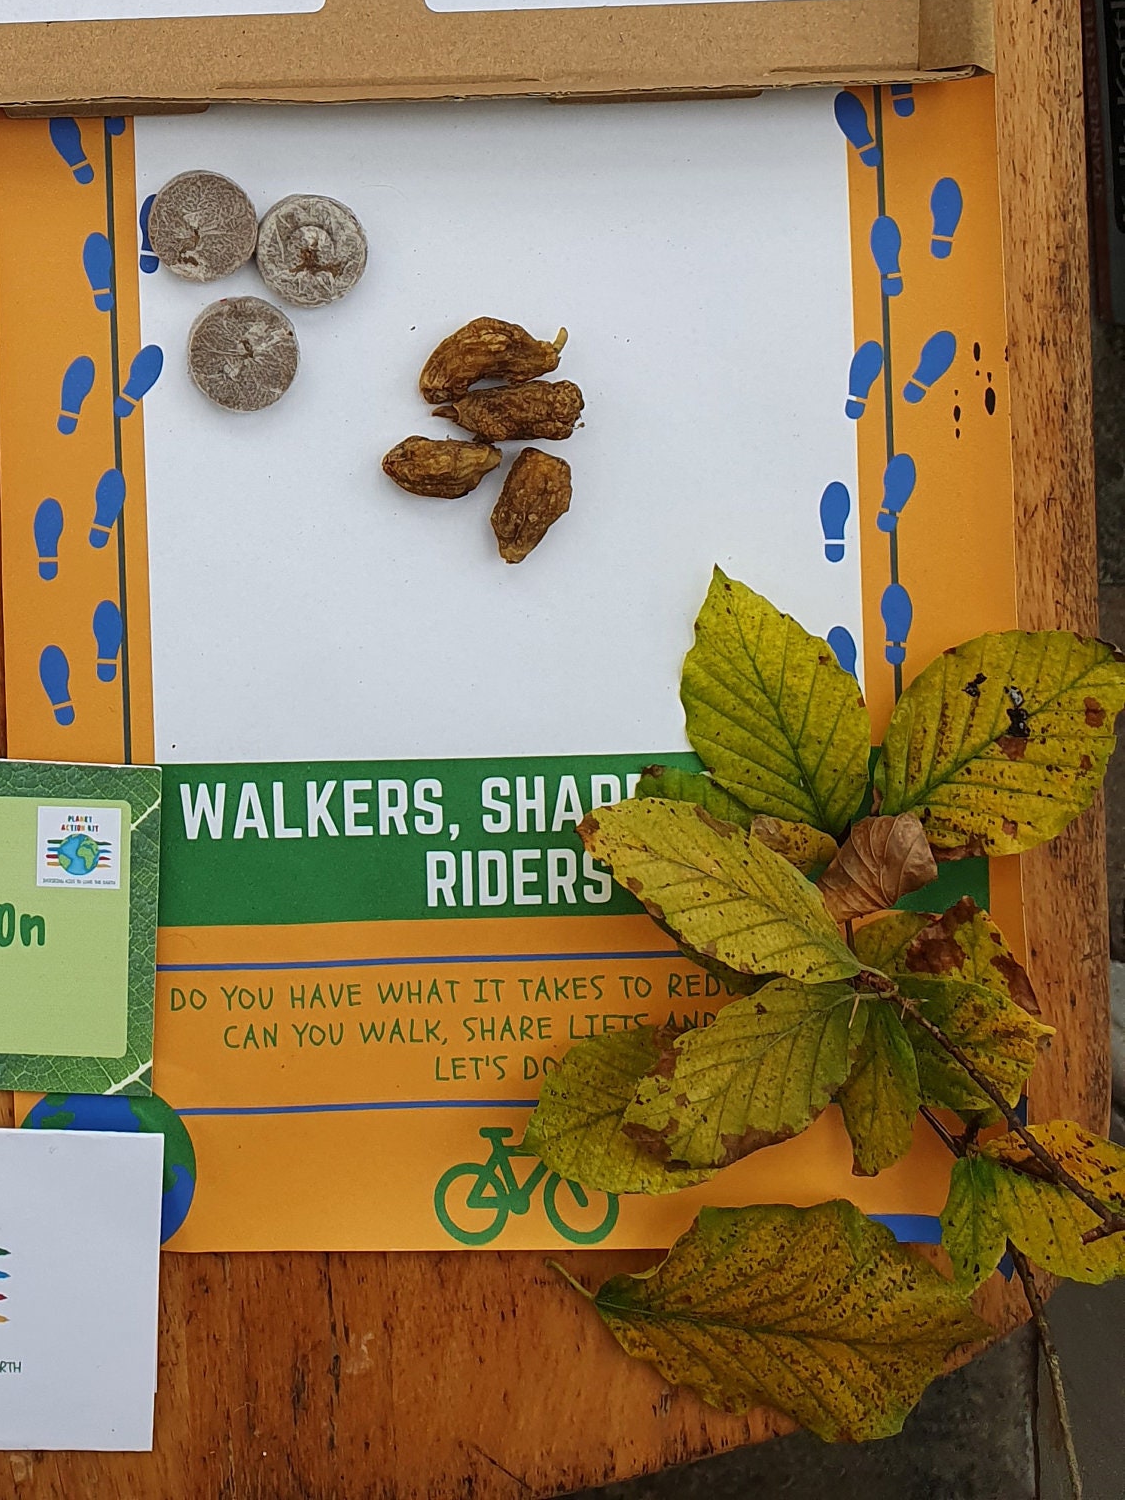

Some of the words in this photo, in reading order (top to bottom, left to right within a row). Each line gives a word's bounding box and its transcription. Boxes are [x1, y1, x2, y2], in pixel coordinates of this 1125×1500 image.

[179, 778, 460, 841] WALKERS,
[170, 987, 208, 1012] DO
[219, 985, 274, 1012] YOU
[290, 982, 362, 1010] HAVE
[377, 978, 461, 1005] WHAT
[472, 977, 506, 1004] IT
[517, 974, 606, 1003] TAKES
[618, 975, 653, 1000] TO
